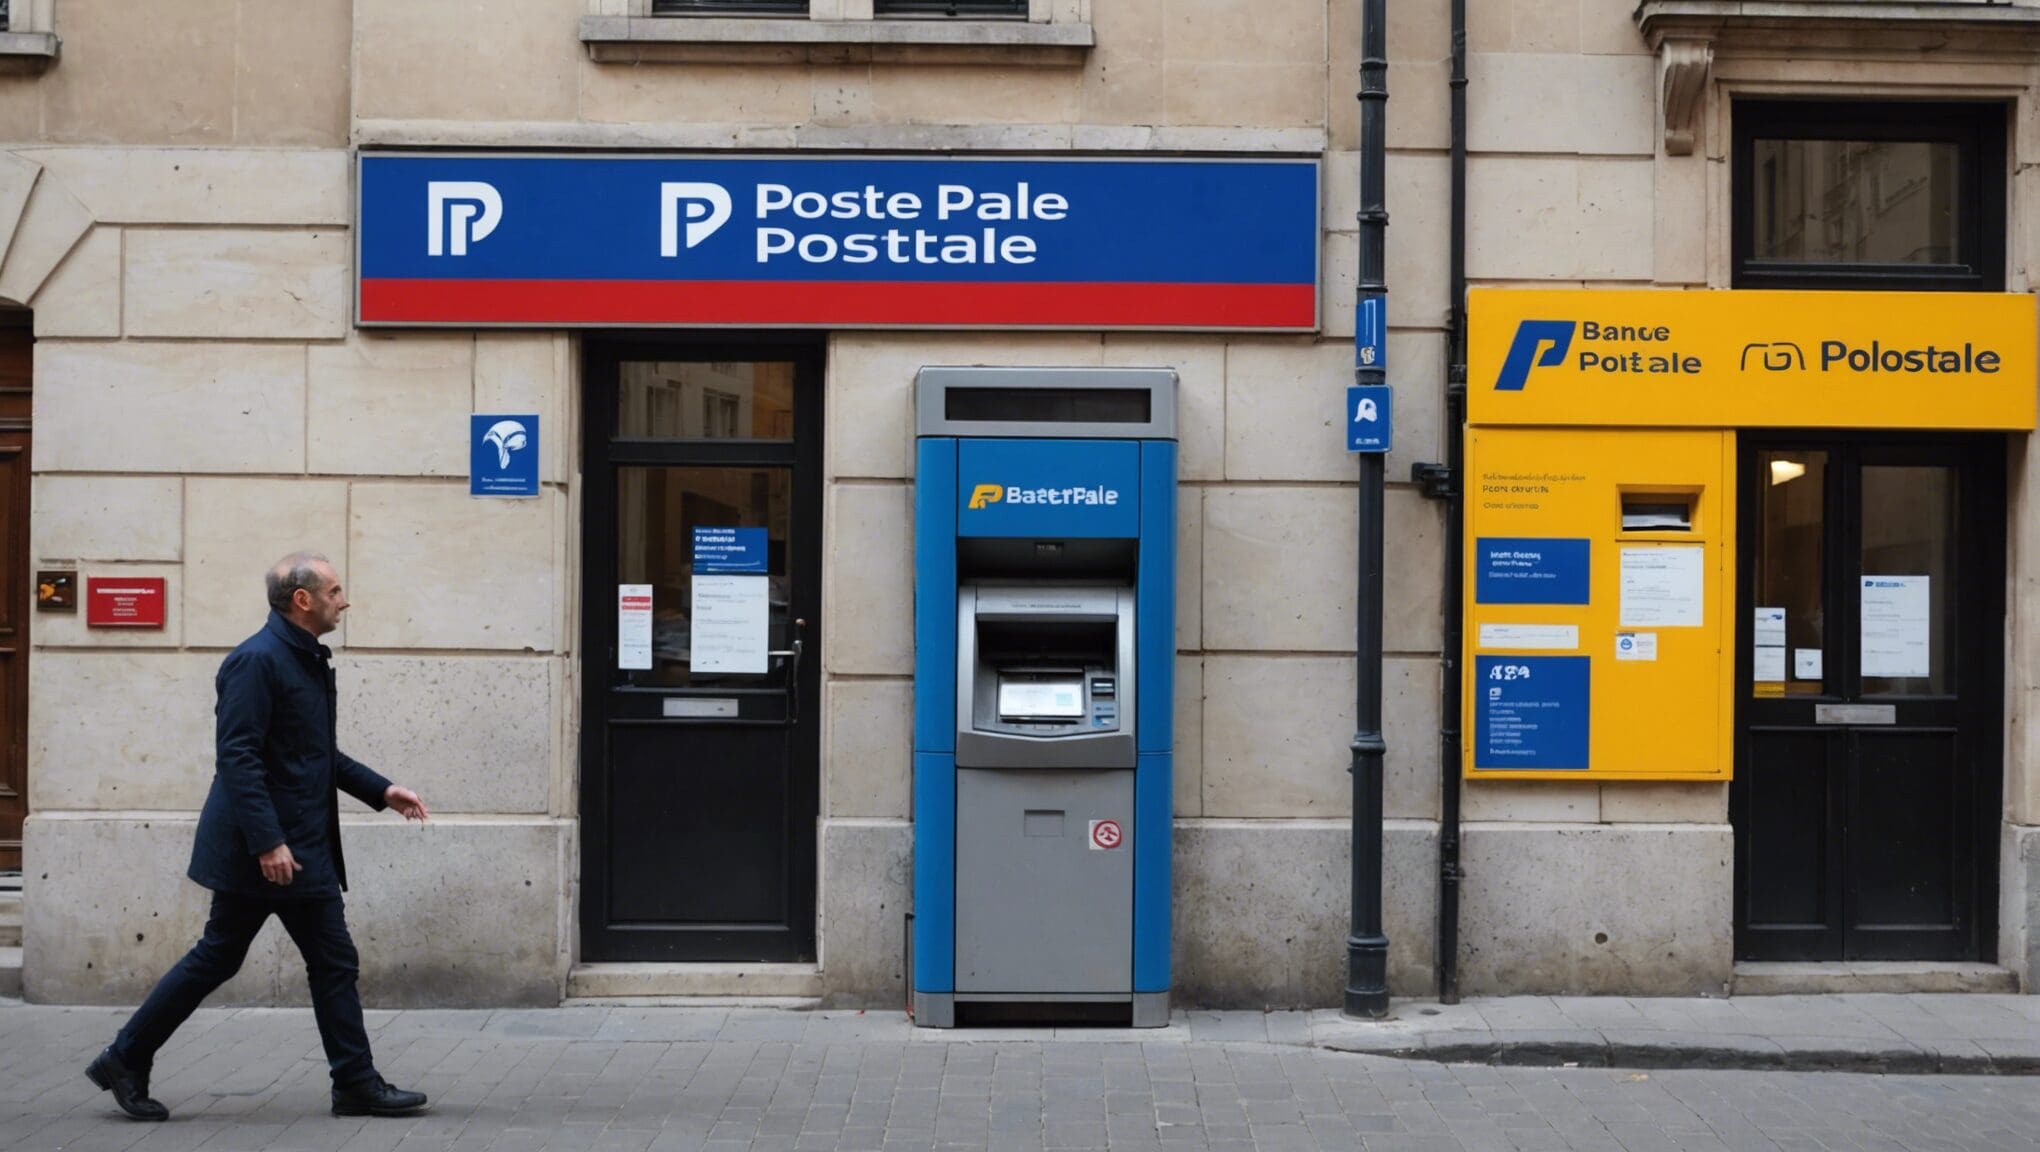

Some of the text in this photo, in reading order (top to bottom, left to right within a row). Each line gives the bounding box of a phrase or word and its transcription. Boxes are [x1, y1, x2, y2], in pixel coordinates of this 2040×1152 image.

[756, 182, 1069, 220] Poste Pale
[756, 227, 1037, 264] Posttale
[1821, 340, 2001, 373] Polostale
